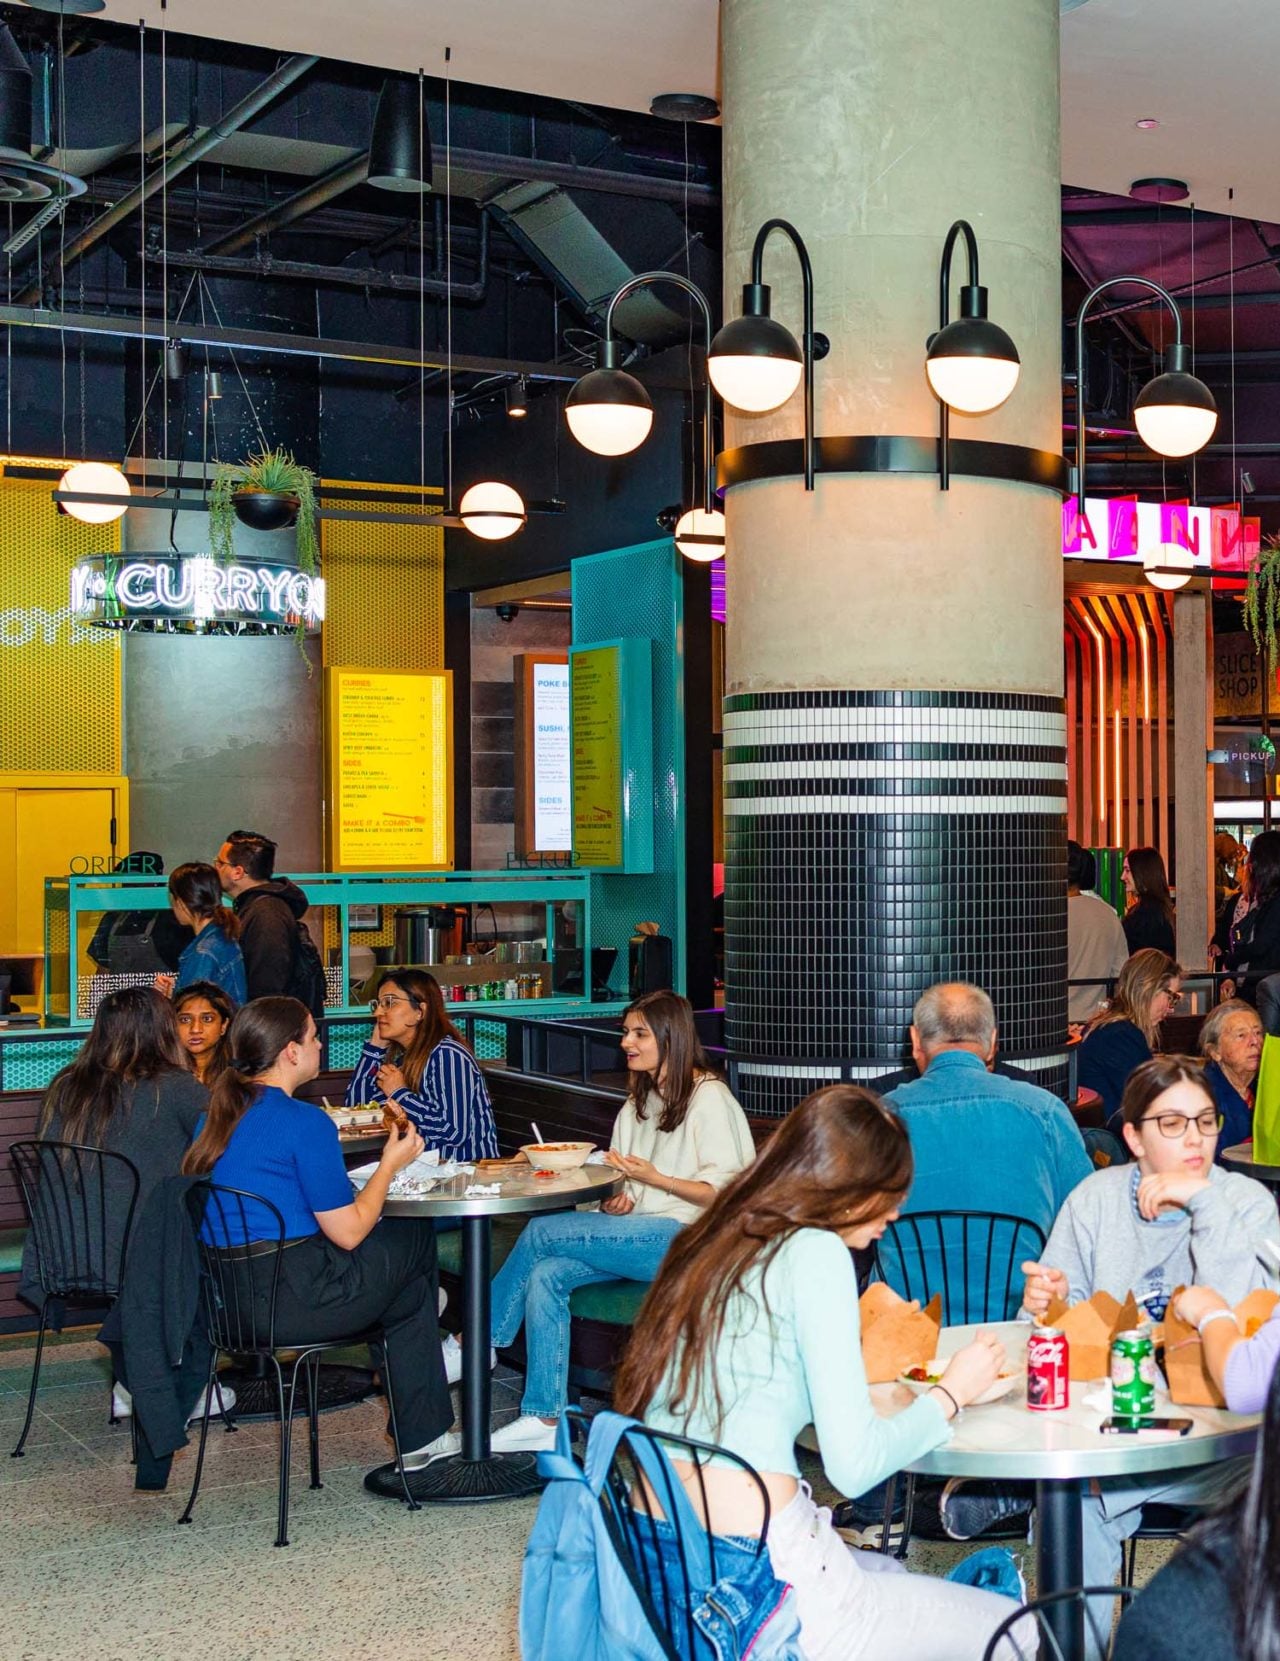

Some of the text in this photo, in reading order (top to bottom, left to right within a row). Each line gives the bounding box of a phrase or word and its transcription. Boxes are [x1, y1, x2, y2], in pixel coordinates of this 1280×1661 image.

[1219, 653, 1257, 675] SLICE
[1219, 677, 1258, 698] SHOP
[1231, 751, 1273, 761] PICKUP
[69, 855, 157, 875] ORDER
[506, 851, 581, 869] PICKUP
